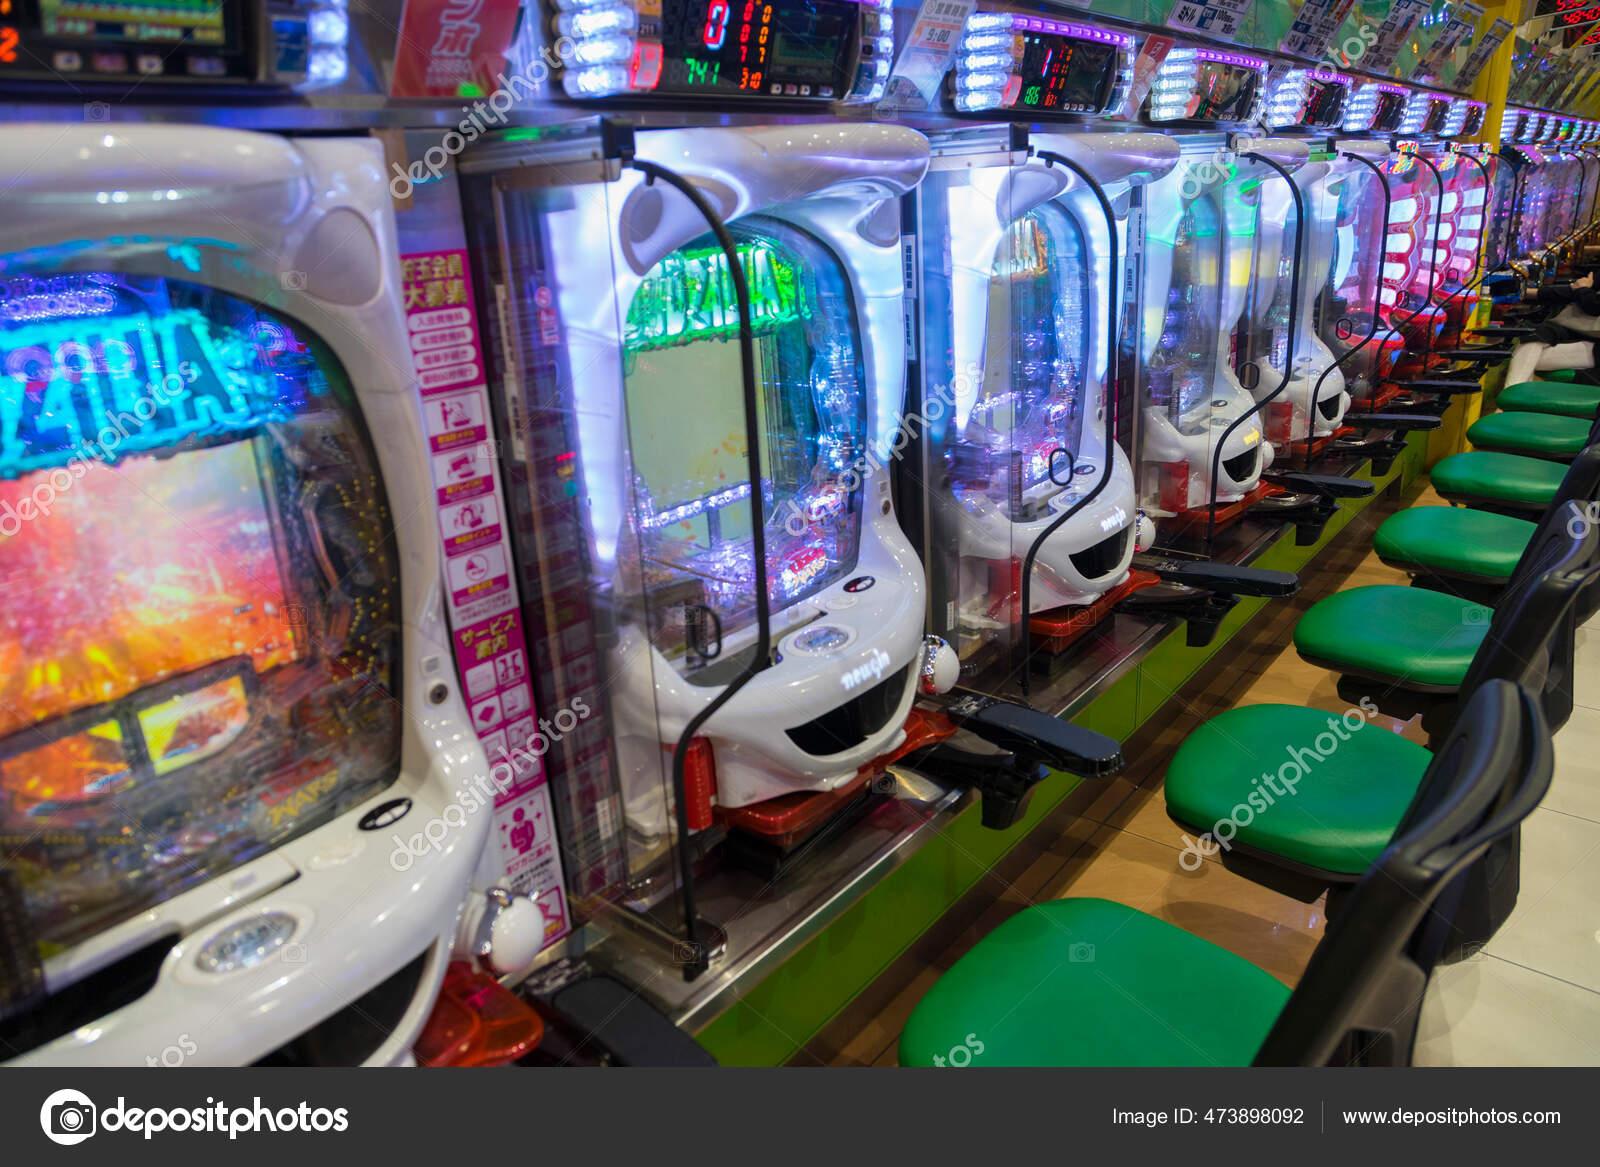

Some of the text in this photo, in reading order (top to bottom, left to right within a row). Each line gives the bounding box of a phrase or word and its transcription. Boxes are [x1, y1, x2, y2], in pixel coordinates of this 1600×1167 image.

[926, 28, 951, 43] 9:00
[460, 614, 517, 648] サービス
[475, 635, 509, 660] 案内
